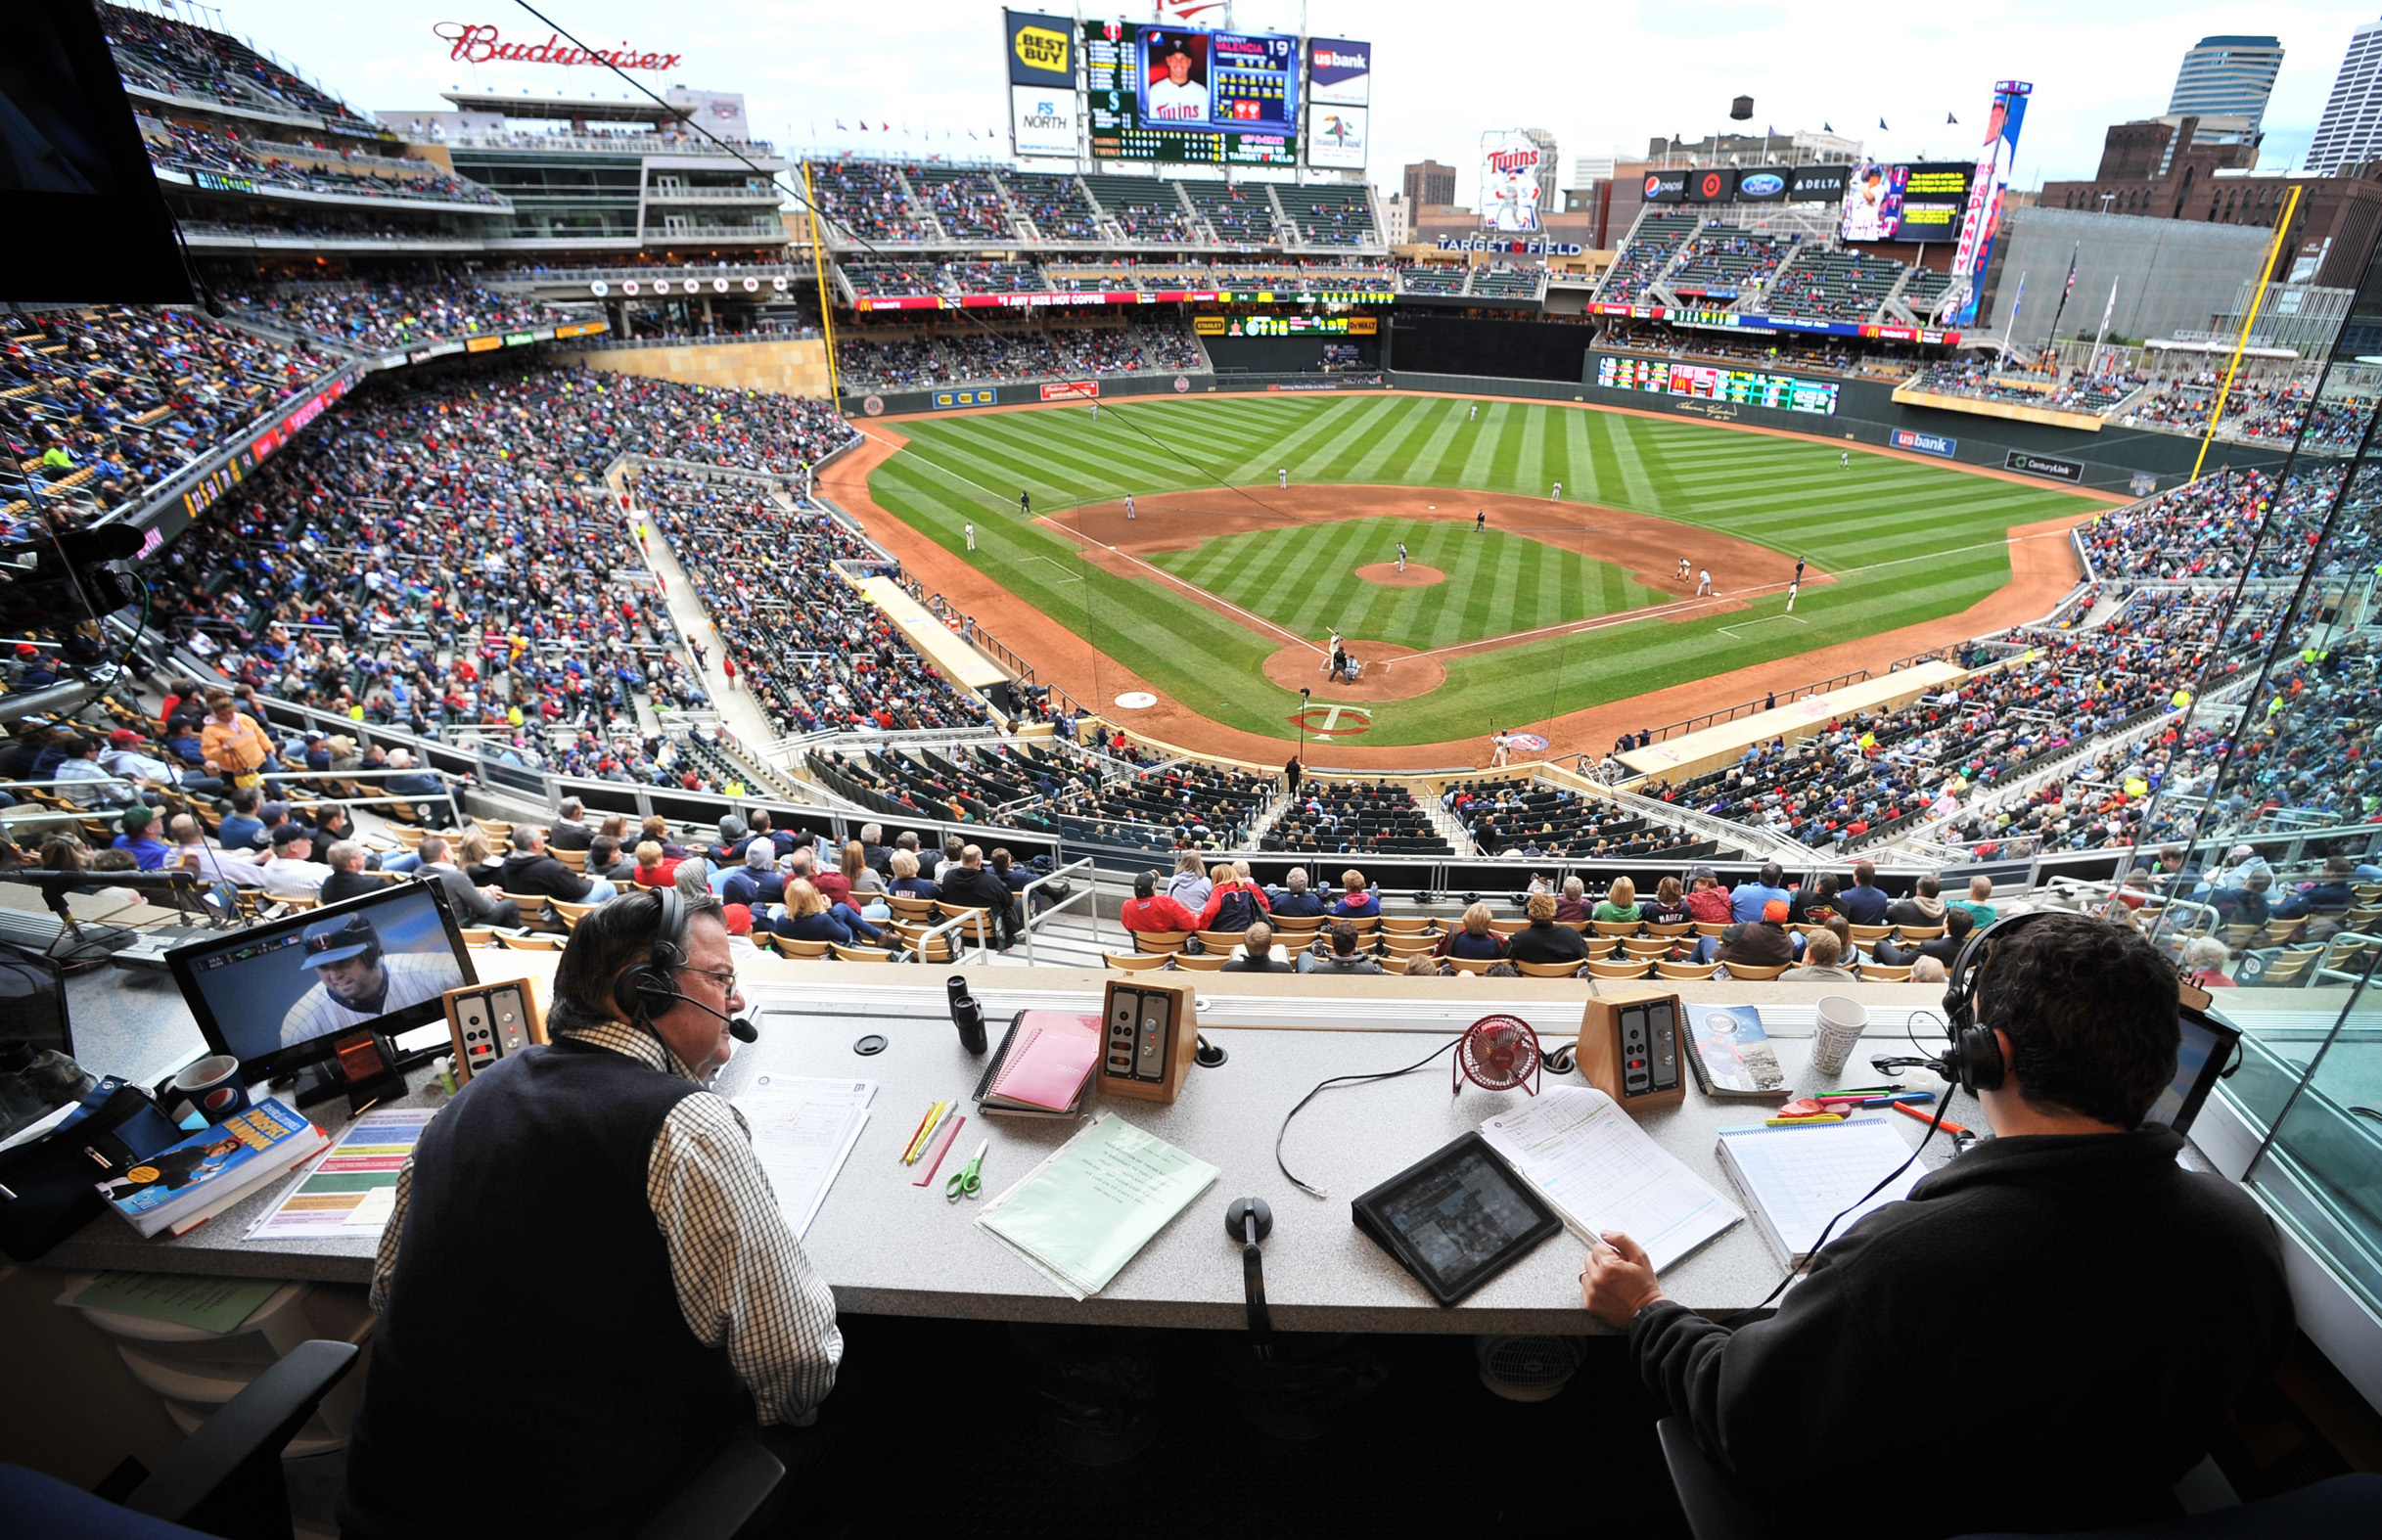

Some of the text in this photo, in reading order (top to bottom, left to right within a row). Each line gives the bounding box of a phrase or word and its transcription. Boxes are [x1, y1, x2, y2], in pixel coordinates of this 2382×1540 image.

[434, 22, 681, 70] Budweiser
[1024, 34, 1065, 52] BEST
[1215, 35, 1247, 44] DANNY
[1215, 41, 1263, 53] VALENCIA
[1025, 48, 1061, 65] BUY
[1268, 40, 1288, 57] 19
[1024, 115, 1067, 129] NORTH
[1095, 148, 1121, 157] TWINS
[1238, 145, 1274, 155] WELCOME
[1488, 149, 1537, 173] Twins
[1659, 180, 1683, 193] pepsi
[1749, 179, 1774, 192] Ford
[1806, 179, 1841, 189] DELTA
[1958, 199, 1981, 270] DANNY
[1439, 239, 1581, 256] TARGET FIELD
[1010, 295, 1029, 306] ANY
[1030, 295, 1051, 305] SIZE
[1052, 294, 1071, 304] HOT
[1072, 294, 1106, 304] COFFEE
[2028, 459, 2070, 475] CenturyLink
[1659, 914, 1683, 925] MAUER
[243, 1109, 291, 1141] PROSPECT
[222, 1116, 275, 1152] HANDBOOK
[1116, 1148, 1135, 1160] PORTION
[1144, 1162, 1159, 1172] TWINS
